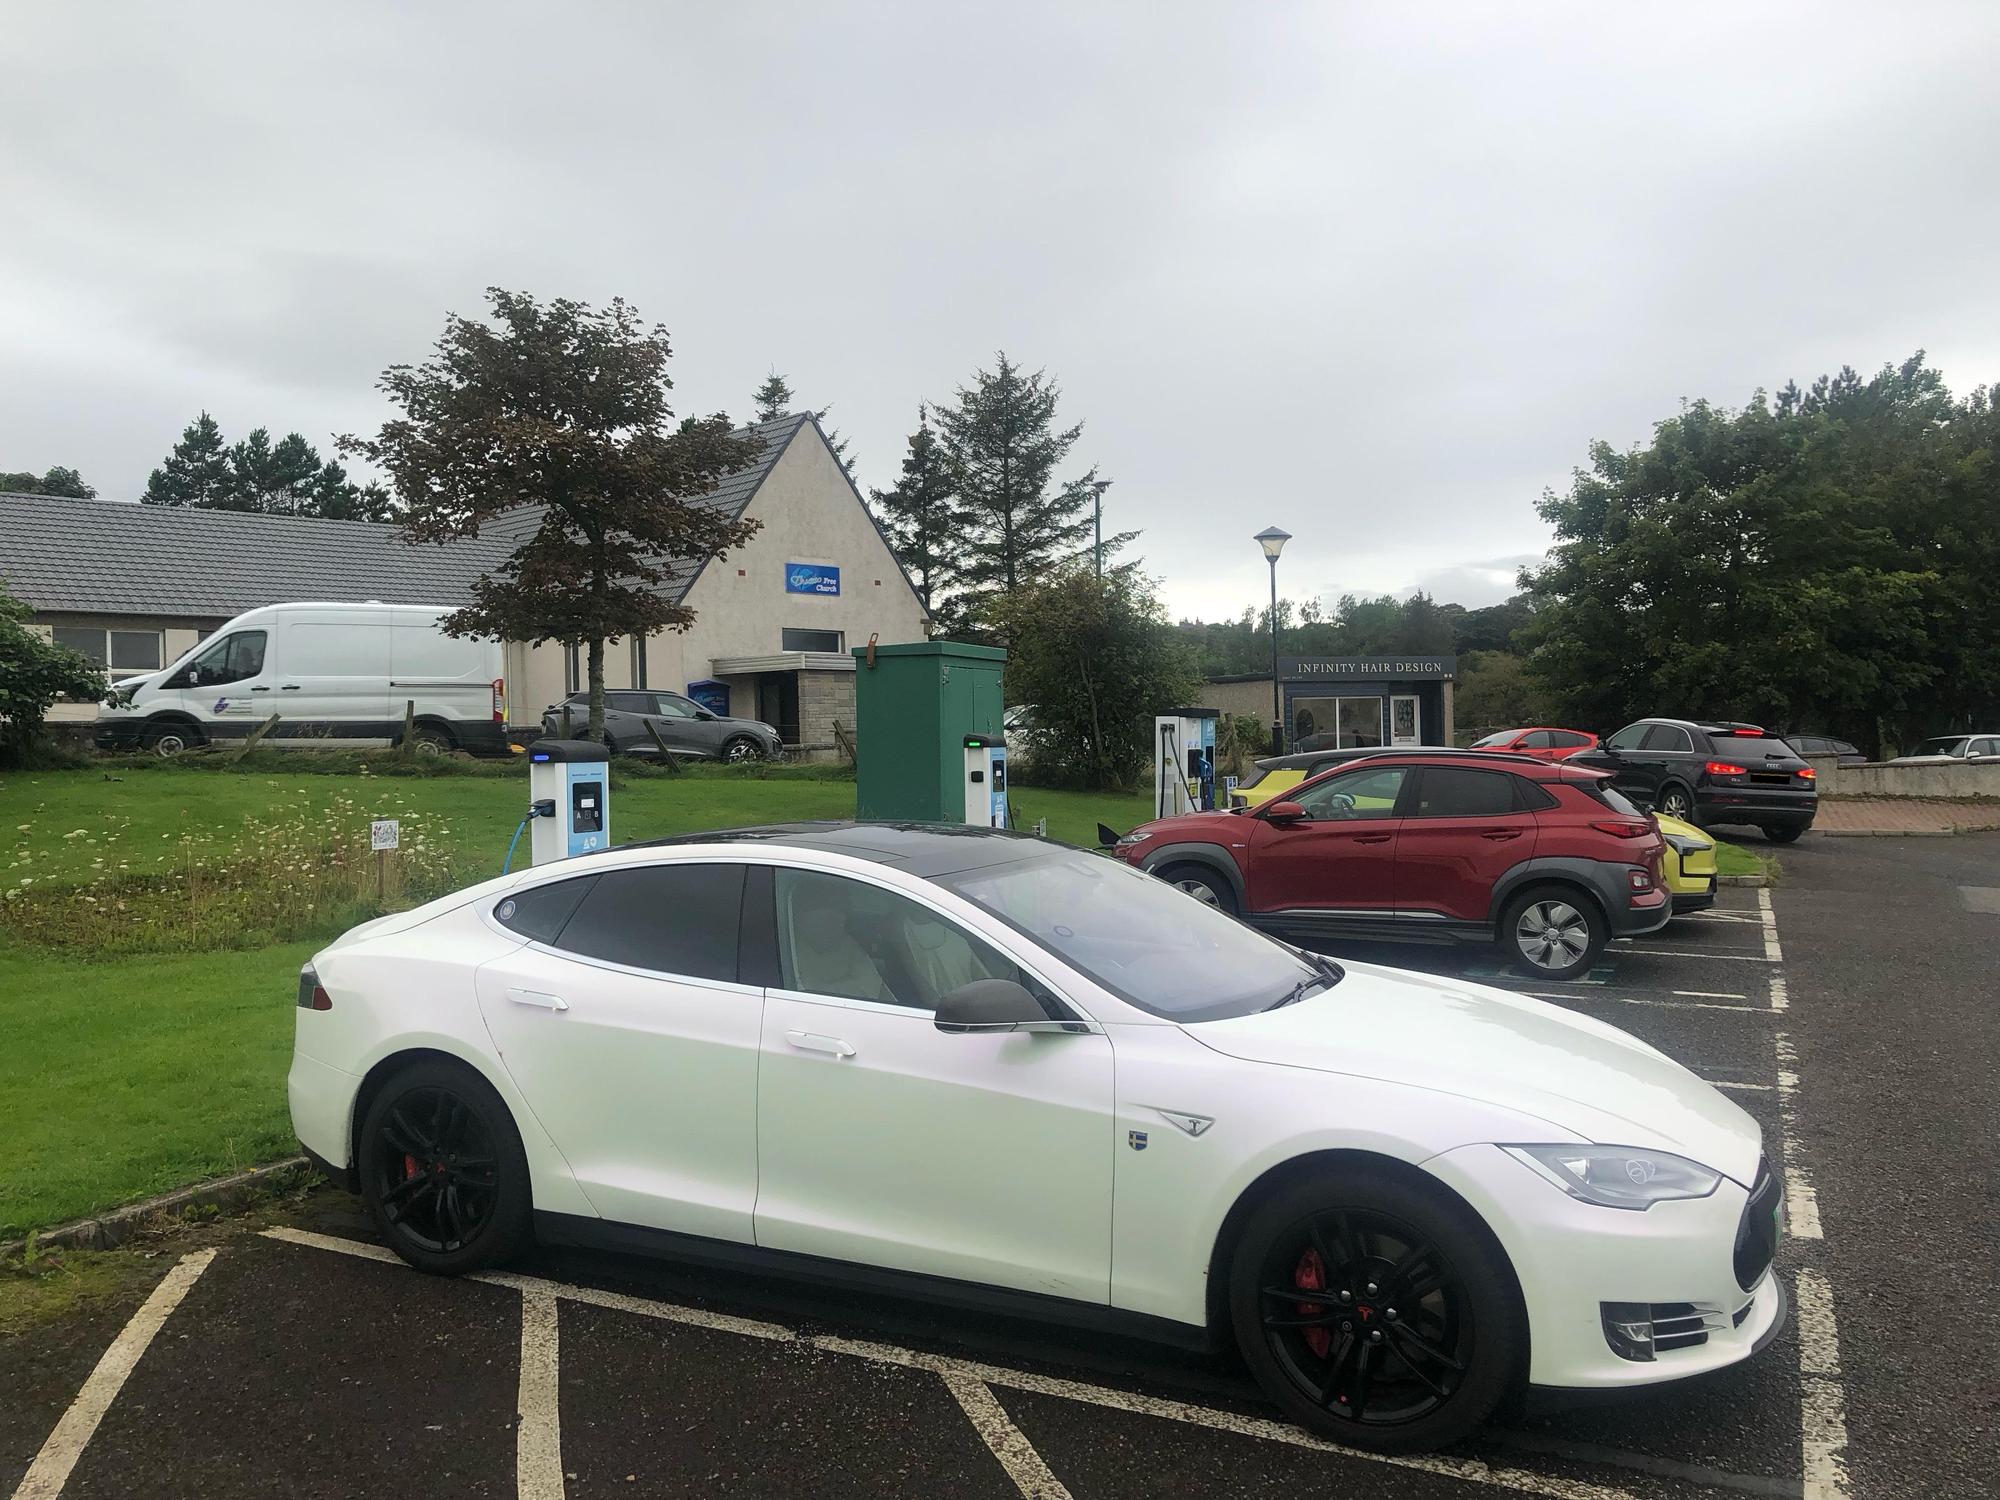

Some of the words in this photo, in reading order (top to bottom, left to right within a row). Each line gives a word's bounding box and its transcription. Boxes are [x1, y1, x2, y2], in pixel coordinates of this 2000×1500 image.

[823, 577, 837, 585] Free
[816, 584, 838, 592] Church
[1297, 663, 1356, 673] INFINITY
[1360, 662, 1391, 673] HAIR
[1395, 662, 1442, 673] DESIGN
[576, 811, 582, 819] A
[594, 810, 599, 818] B
